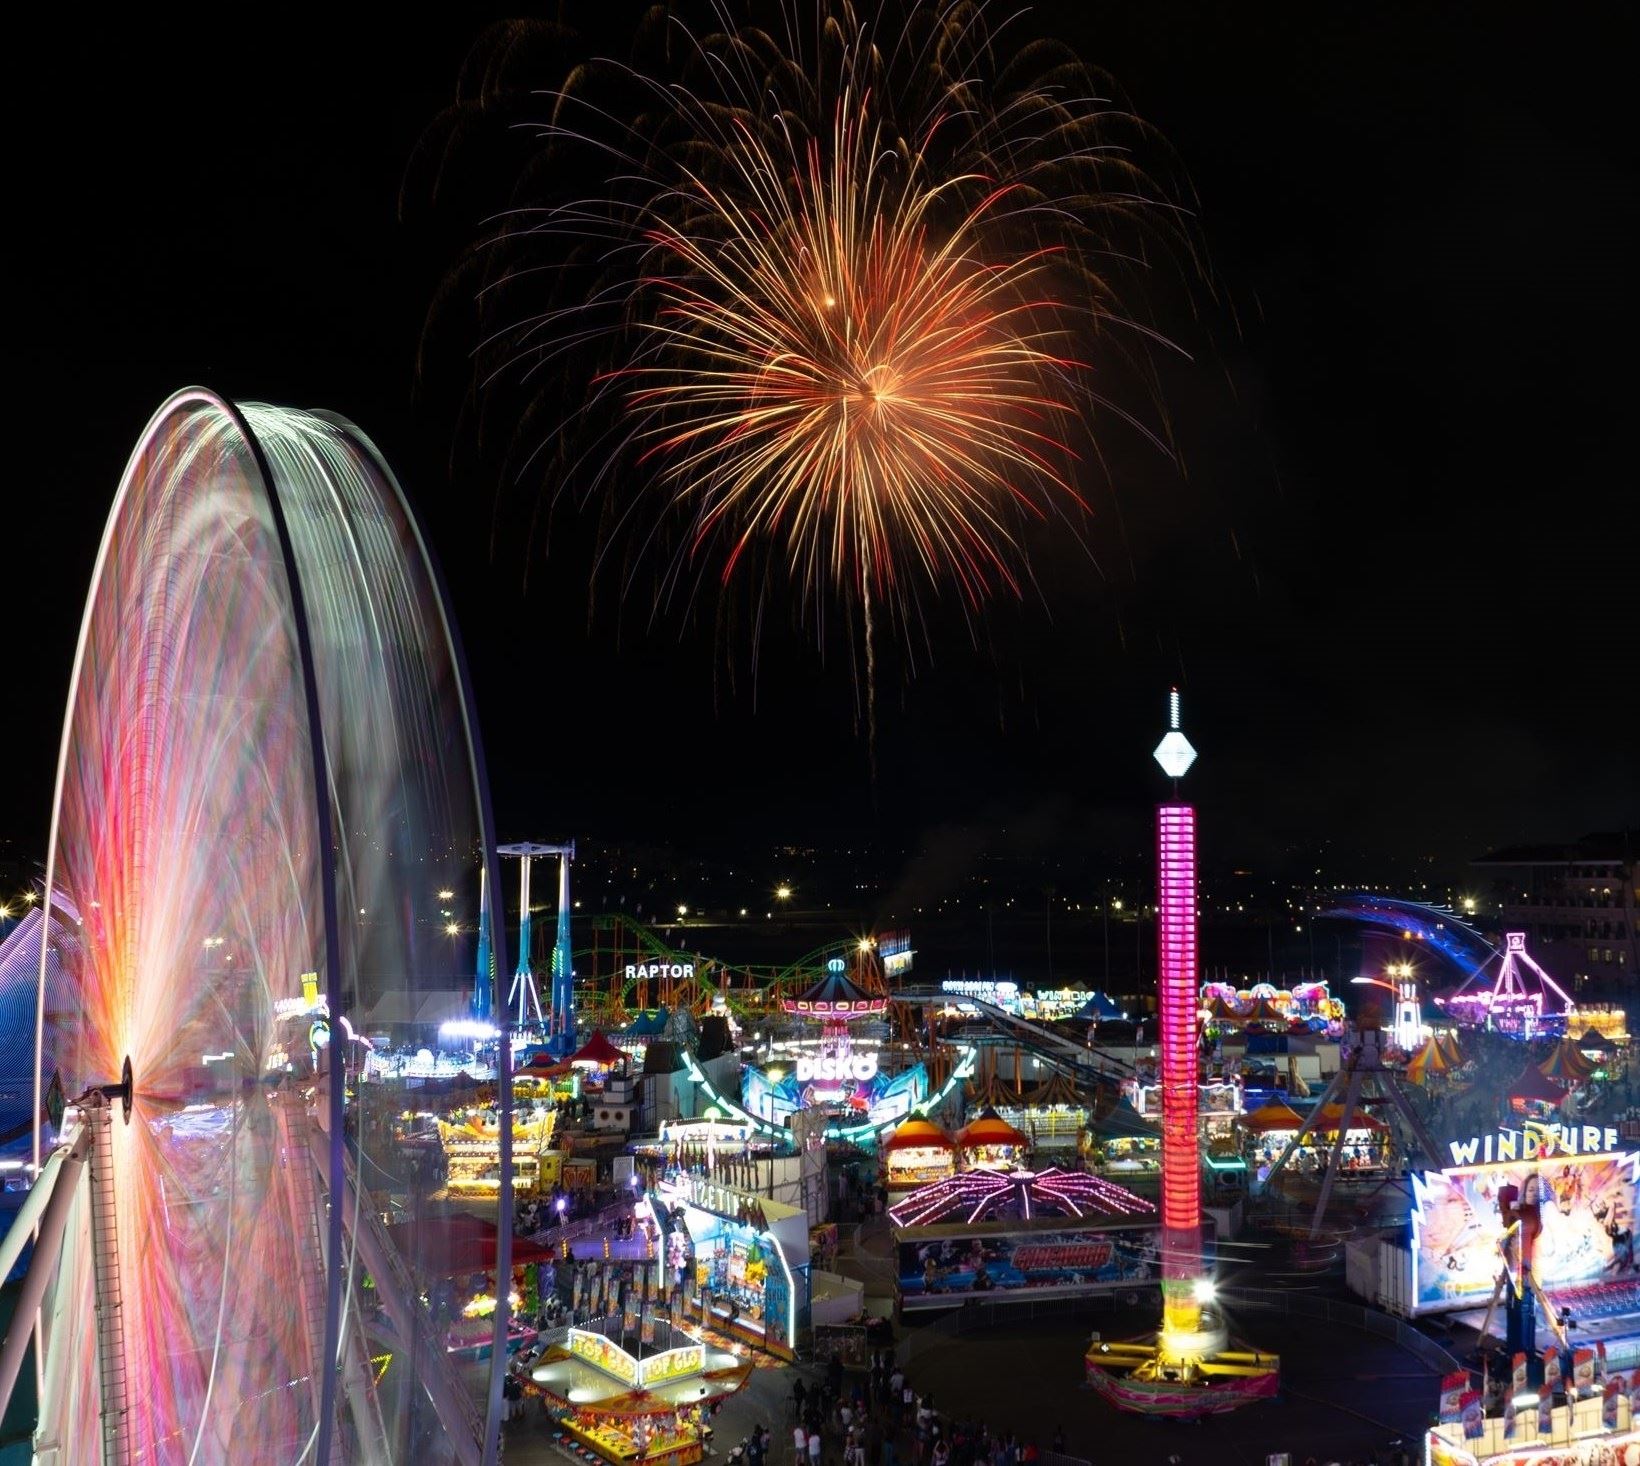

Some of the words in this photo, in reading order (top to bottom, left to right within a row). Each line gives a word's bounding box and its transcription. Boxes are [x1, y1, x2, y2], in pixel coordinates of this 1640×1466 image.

[625, 964, 694, 979] RAPTOR
[646, 1355, 671, 1379] TOP
[673, 1349, 699, 1373] GLO
